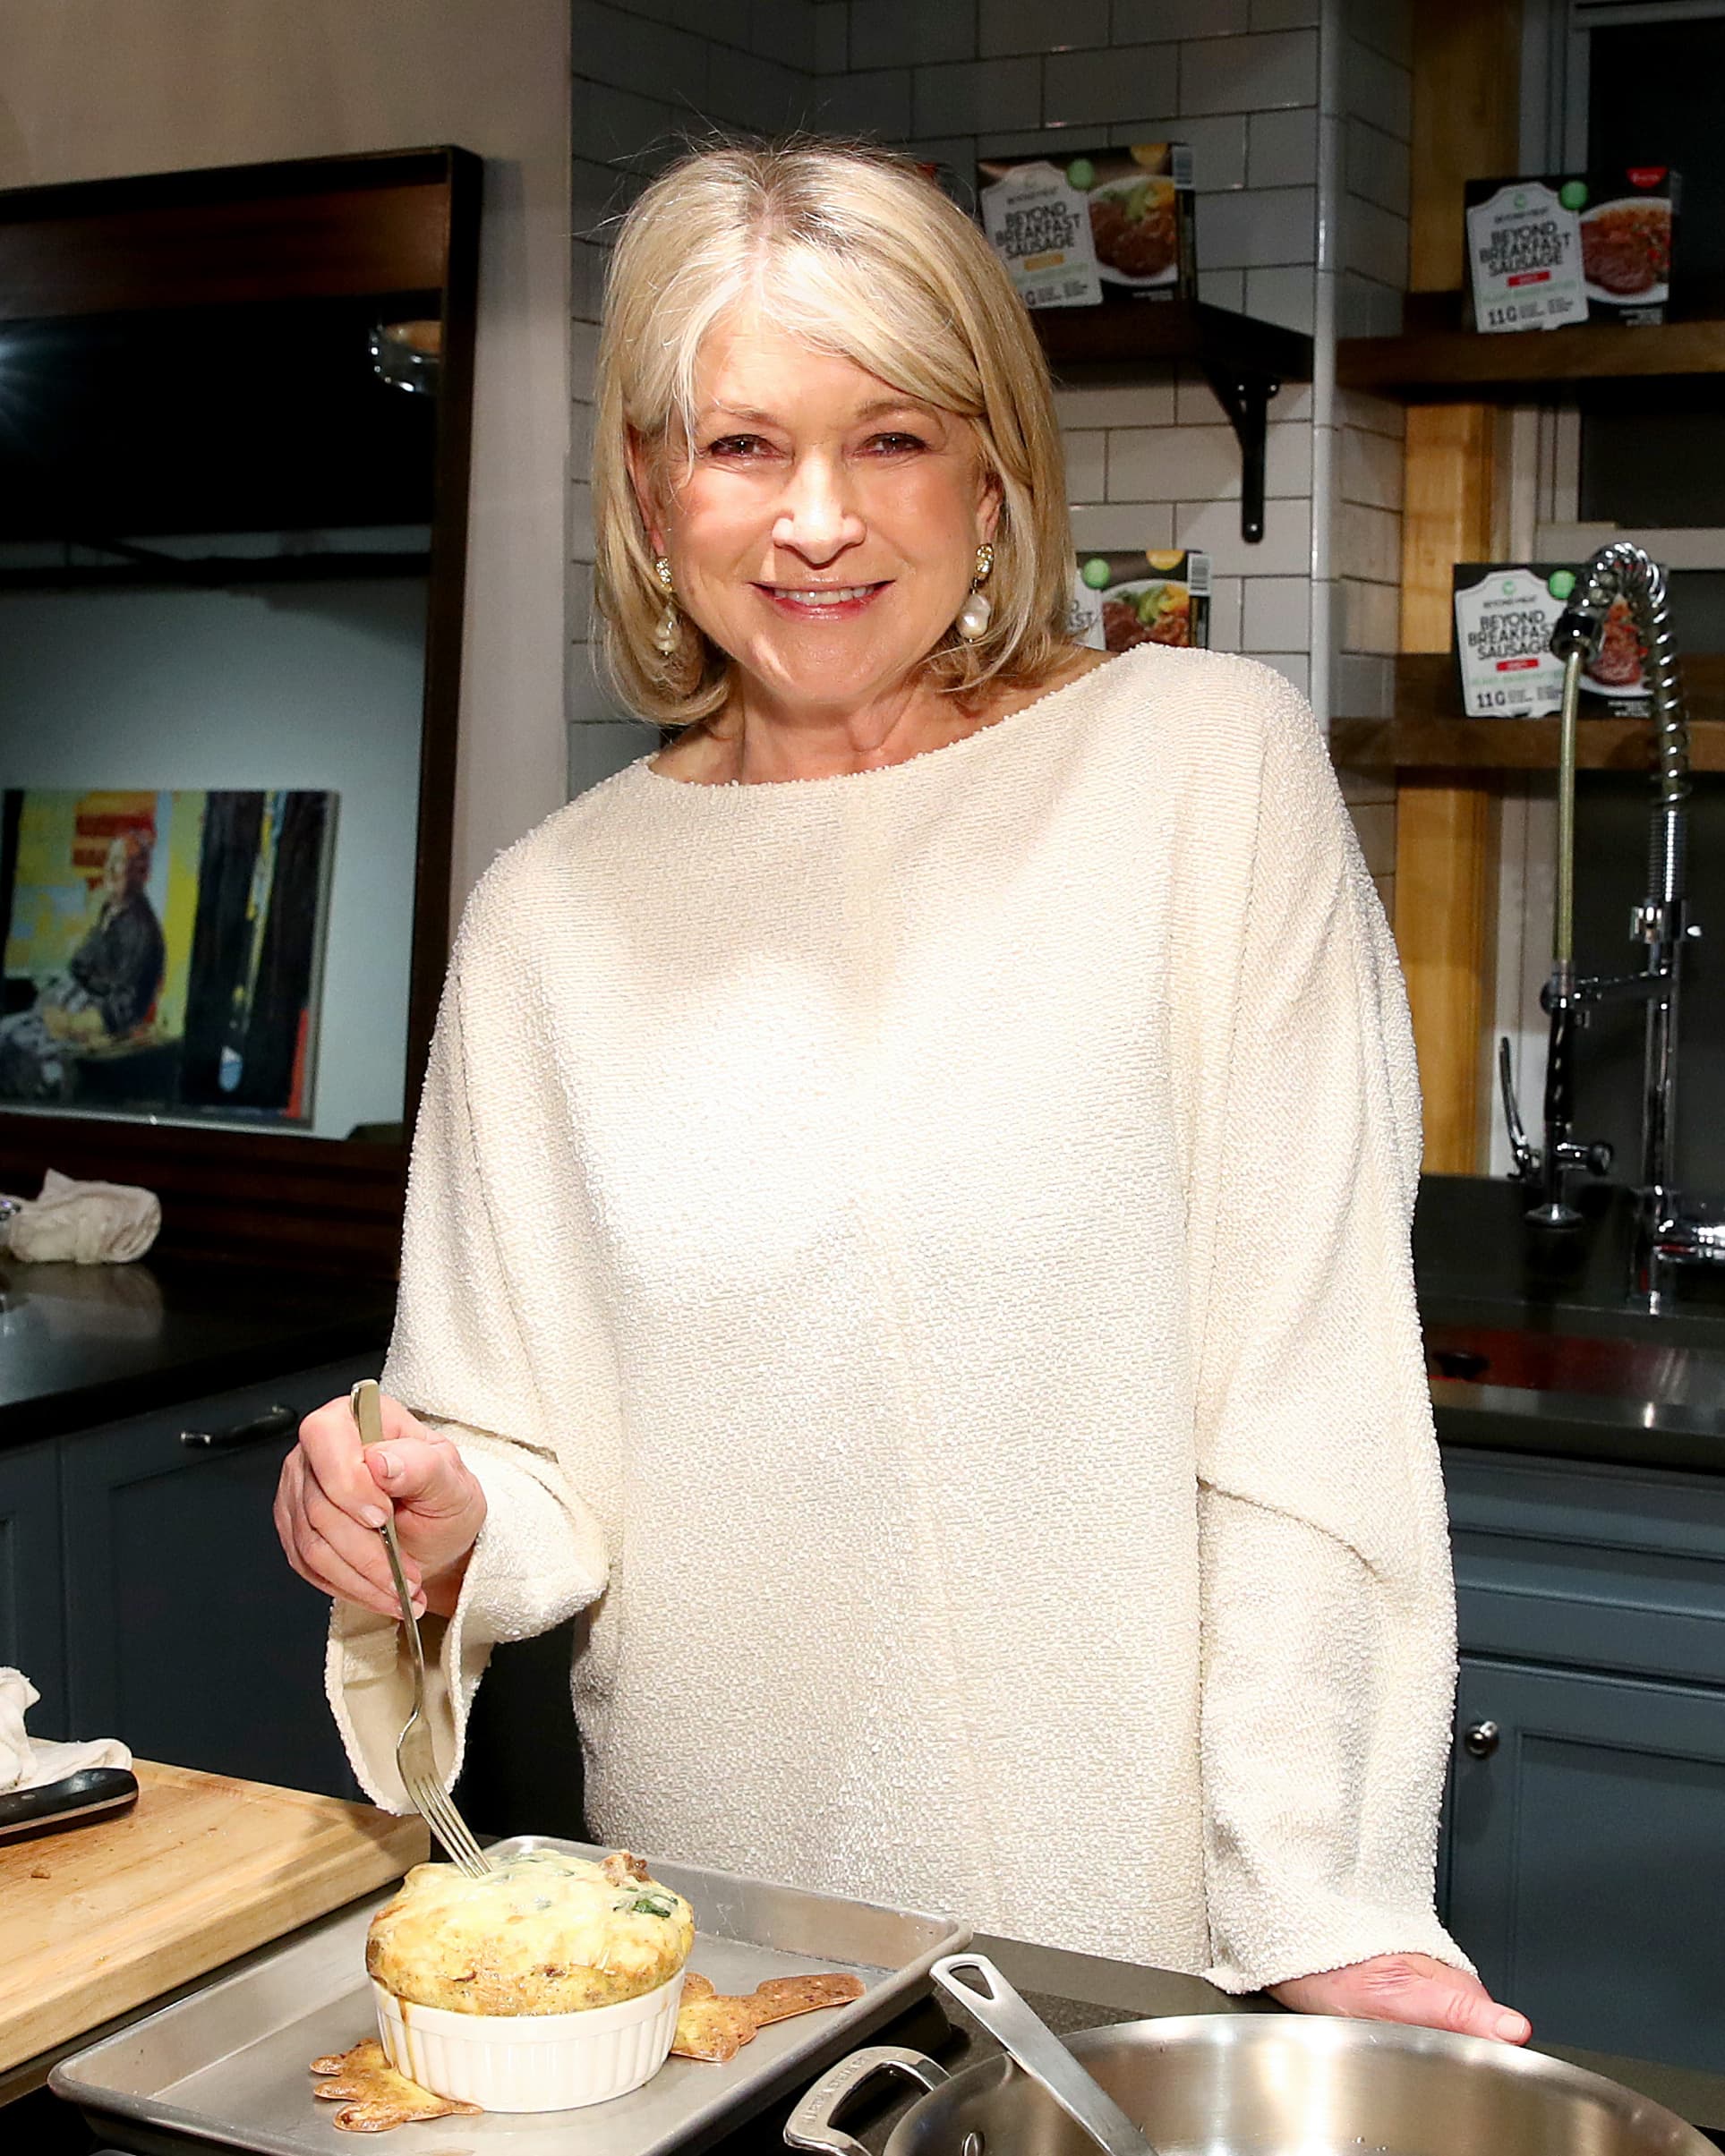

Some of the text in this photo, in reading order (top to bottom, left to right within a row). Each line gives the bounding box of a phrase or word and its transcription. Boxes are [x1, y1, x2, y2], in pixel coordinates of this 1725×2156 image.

[1490, 221, 1558, 245] BEYOND
[1479, 232, 1571, 264] BREAKFAST
[1489, 251, 1563, 277] SAUSAGE
[1480, 609, 1545, 630] BEYOND
[1468, 623, 1556, 647] BREAKFAS
